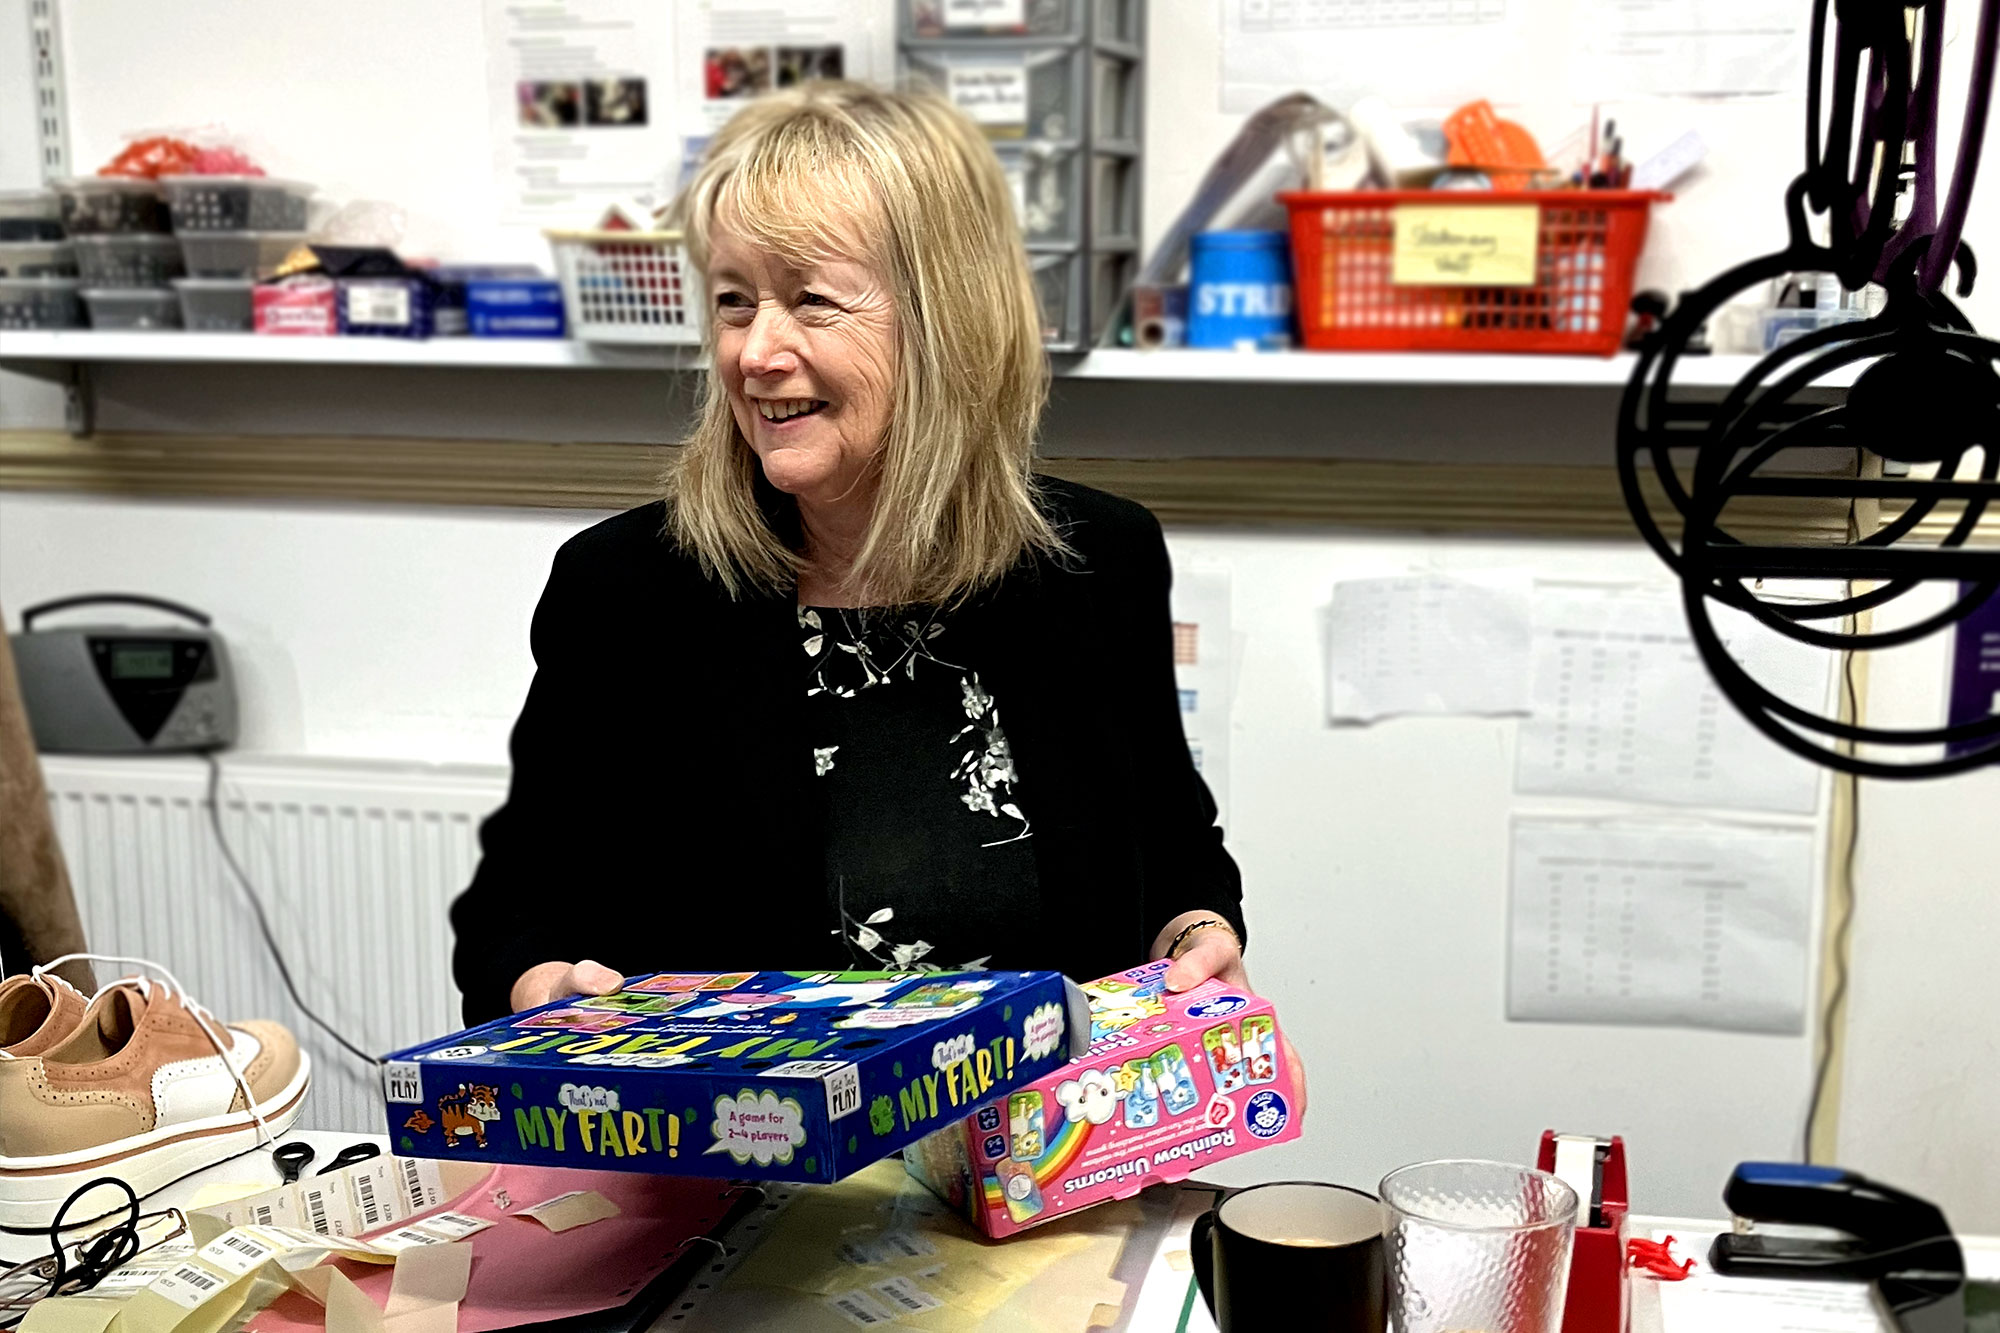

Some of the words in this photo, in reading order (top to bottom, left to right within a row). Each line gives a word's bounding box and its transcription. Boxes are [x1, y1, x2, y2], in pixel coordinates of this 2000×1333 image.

[490, 1031, 712, 1056] FART!
[697, 1037, 842, 1058] MY
[391, 1080, 418, 1099] PLAY
[899, 1072, 939, 1131] MY
[946, 1036, 1014, 1107] FART!
[567, 1089, 592, 1107] That's
[595, 1093, 609, 1108] not
[833, 1086, 857, 1114] PLAY
[729, 1111, 737, 1121] A
[739, 1112, 766, 1127] game
[768, 1112, 784, 1124] for
[514, 1106, 568, 1152] MY
[578, 1107, 680, 1158] FART!
[751, 1130, 789, 1144] players
[1154, 1128, 1236, 1165] Rainbow
[1064, 1156, 1150, 1193] Unicorns
[383, 1203, 392, 1221] £2.00
